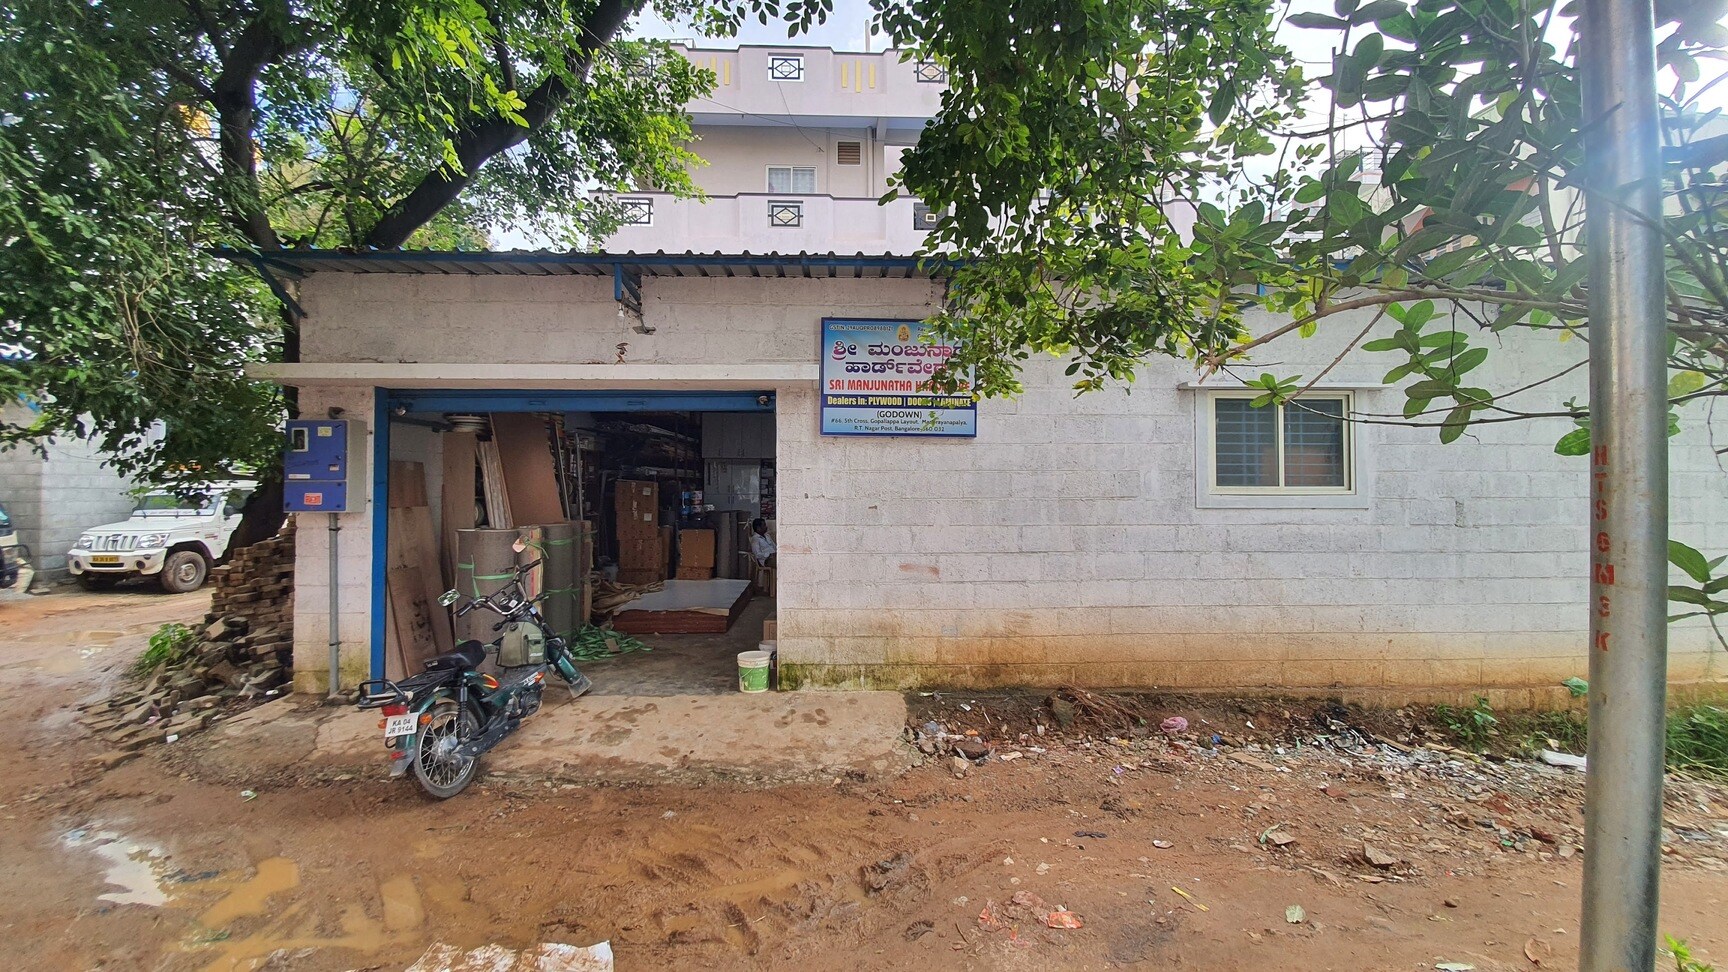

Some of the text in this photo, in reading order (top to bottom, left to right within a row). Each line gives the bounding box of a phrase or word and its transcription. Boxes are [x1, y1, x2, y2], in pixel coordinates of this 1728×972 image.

[832, 340, 857, 361] ಶ್ರೀ
[829, 379, 845, 390] SRI
[847, 379, 912, 391] MANJUNATHA
[827, 396, 857, 405] Dealers
[868, 396, 903, 406] PLYWOOD
[907, 396, 932, 406] DOOS
[876, 410, 923, 419] (GODOWN)
[392, 718, 411, 727] KA 04
[388, 724, 413, 735] JR 9144
